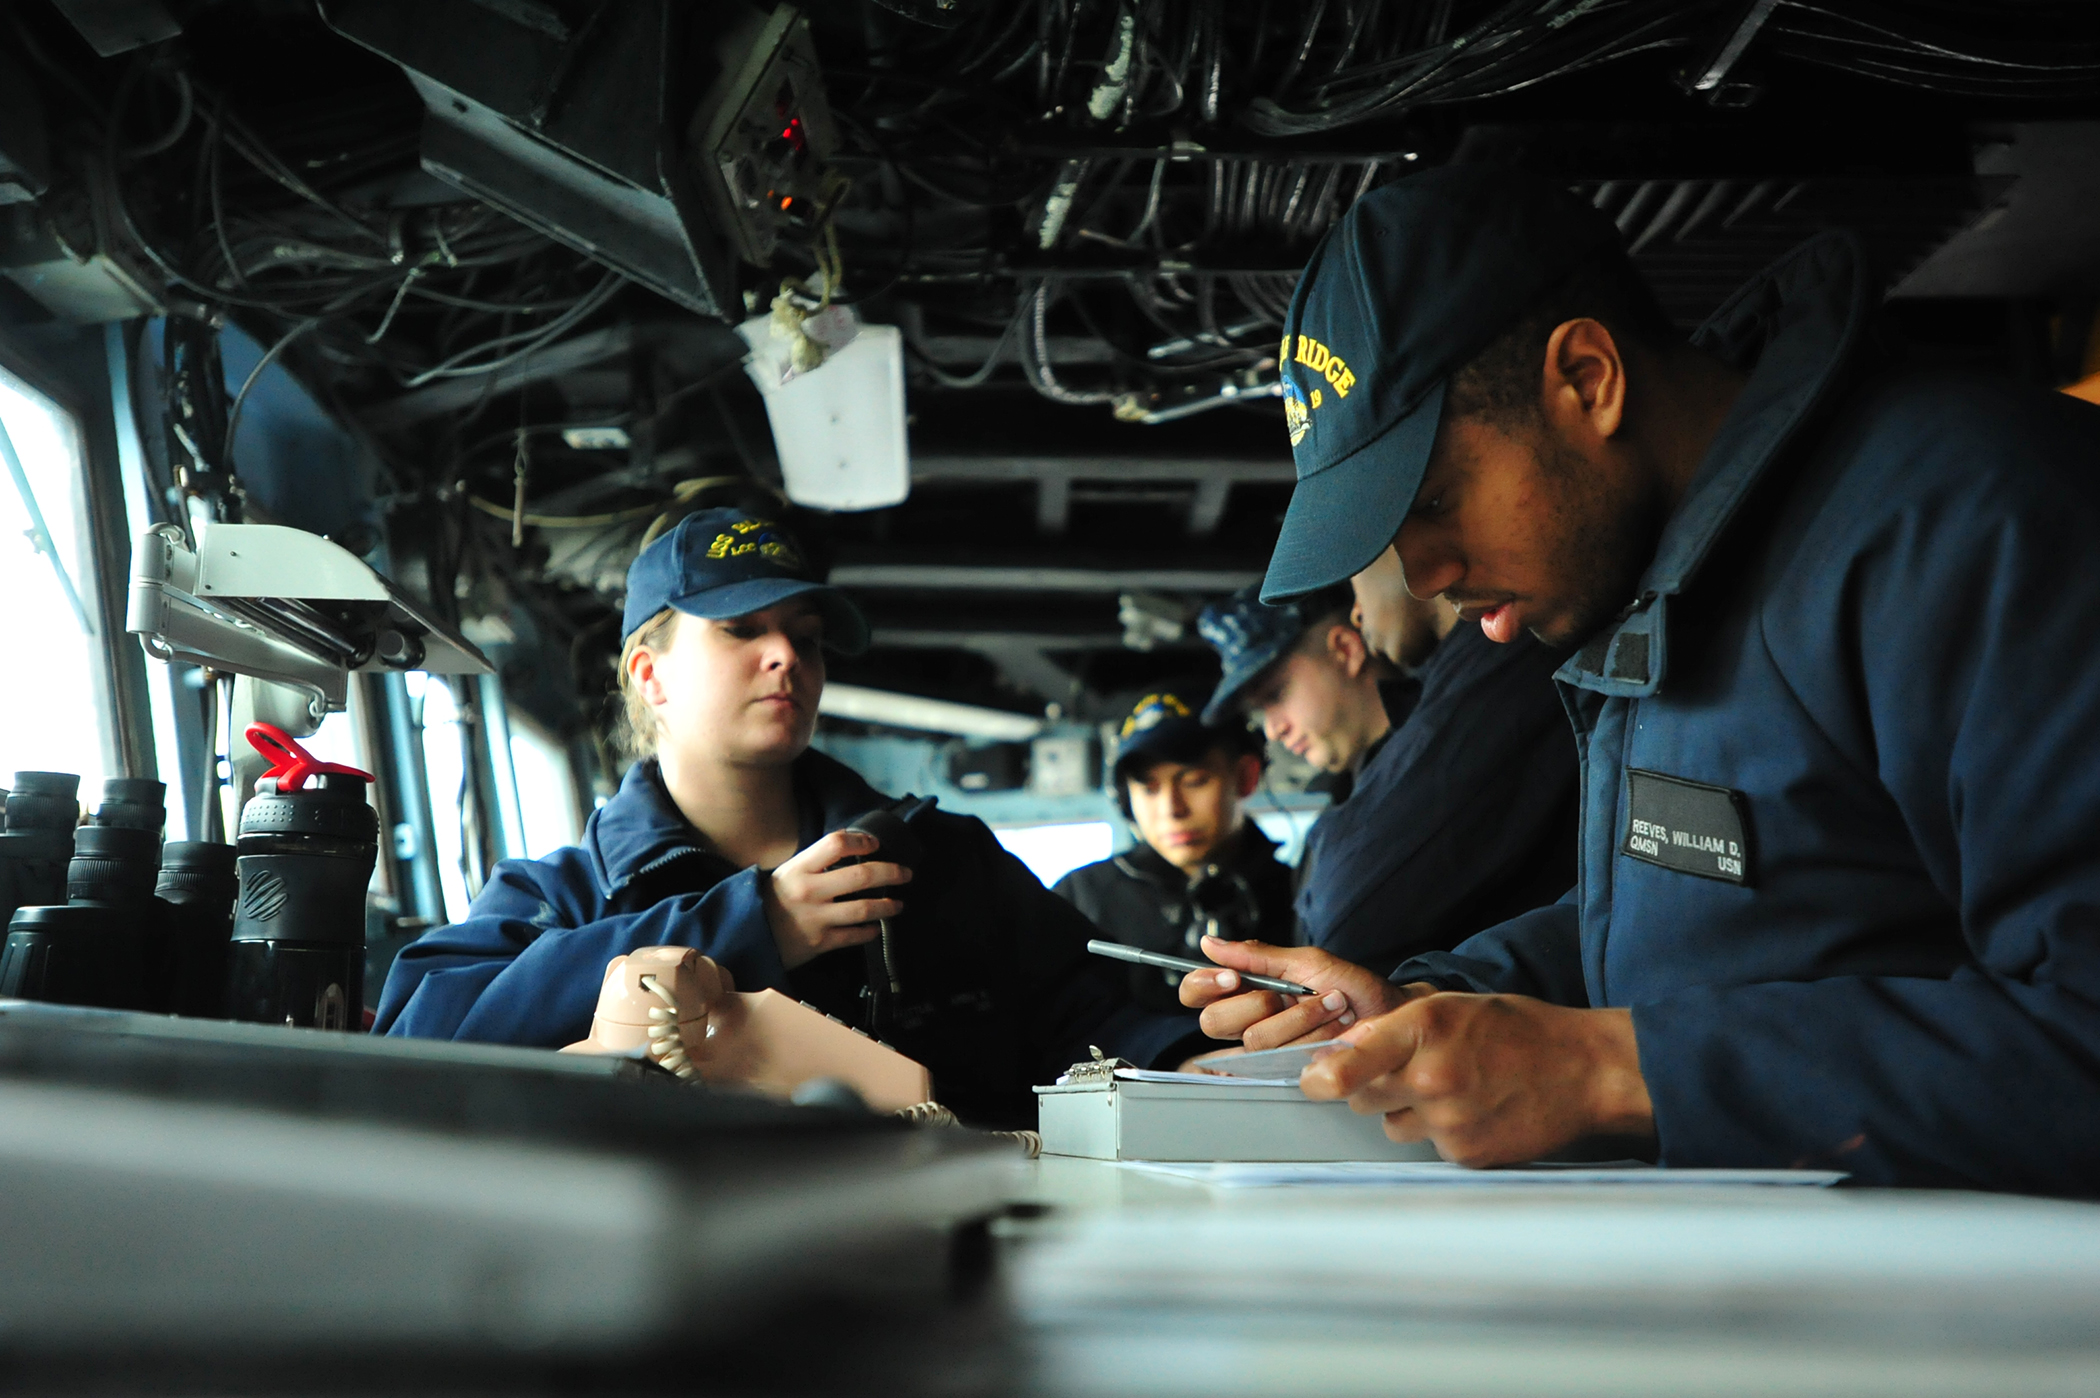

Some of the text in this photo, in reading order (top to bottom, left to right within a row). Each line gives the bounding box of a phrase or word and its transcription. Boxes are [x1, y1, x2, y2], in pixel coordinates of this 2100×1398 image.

[1294, 334, 1356, 399] RIDGE
[1309, 388, 1323, 409] 19
[705, 533, 735, 559] USS
[731, 542, 757, 557] LCC
[1630, 835, 1659, 857] QMSN
[1632, 818, 1741, 858] REEVES, WILLIAM D.
[1717, 856, 1742, 876] USN
